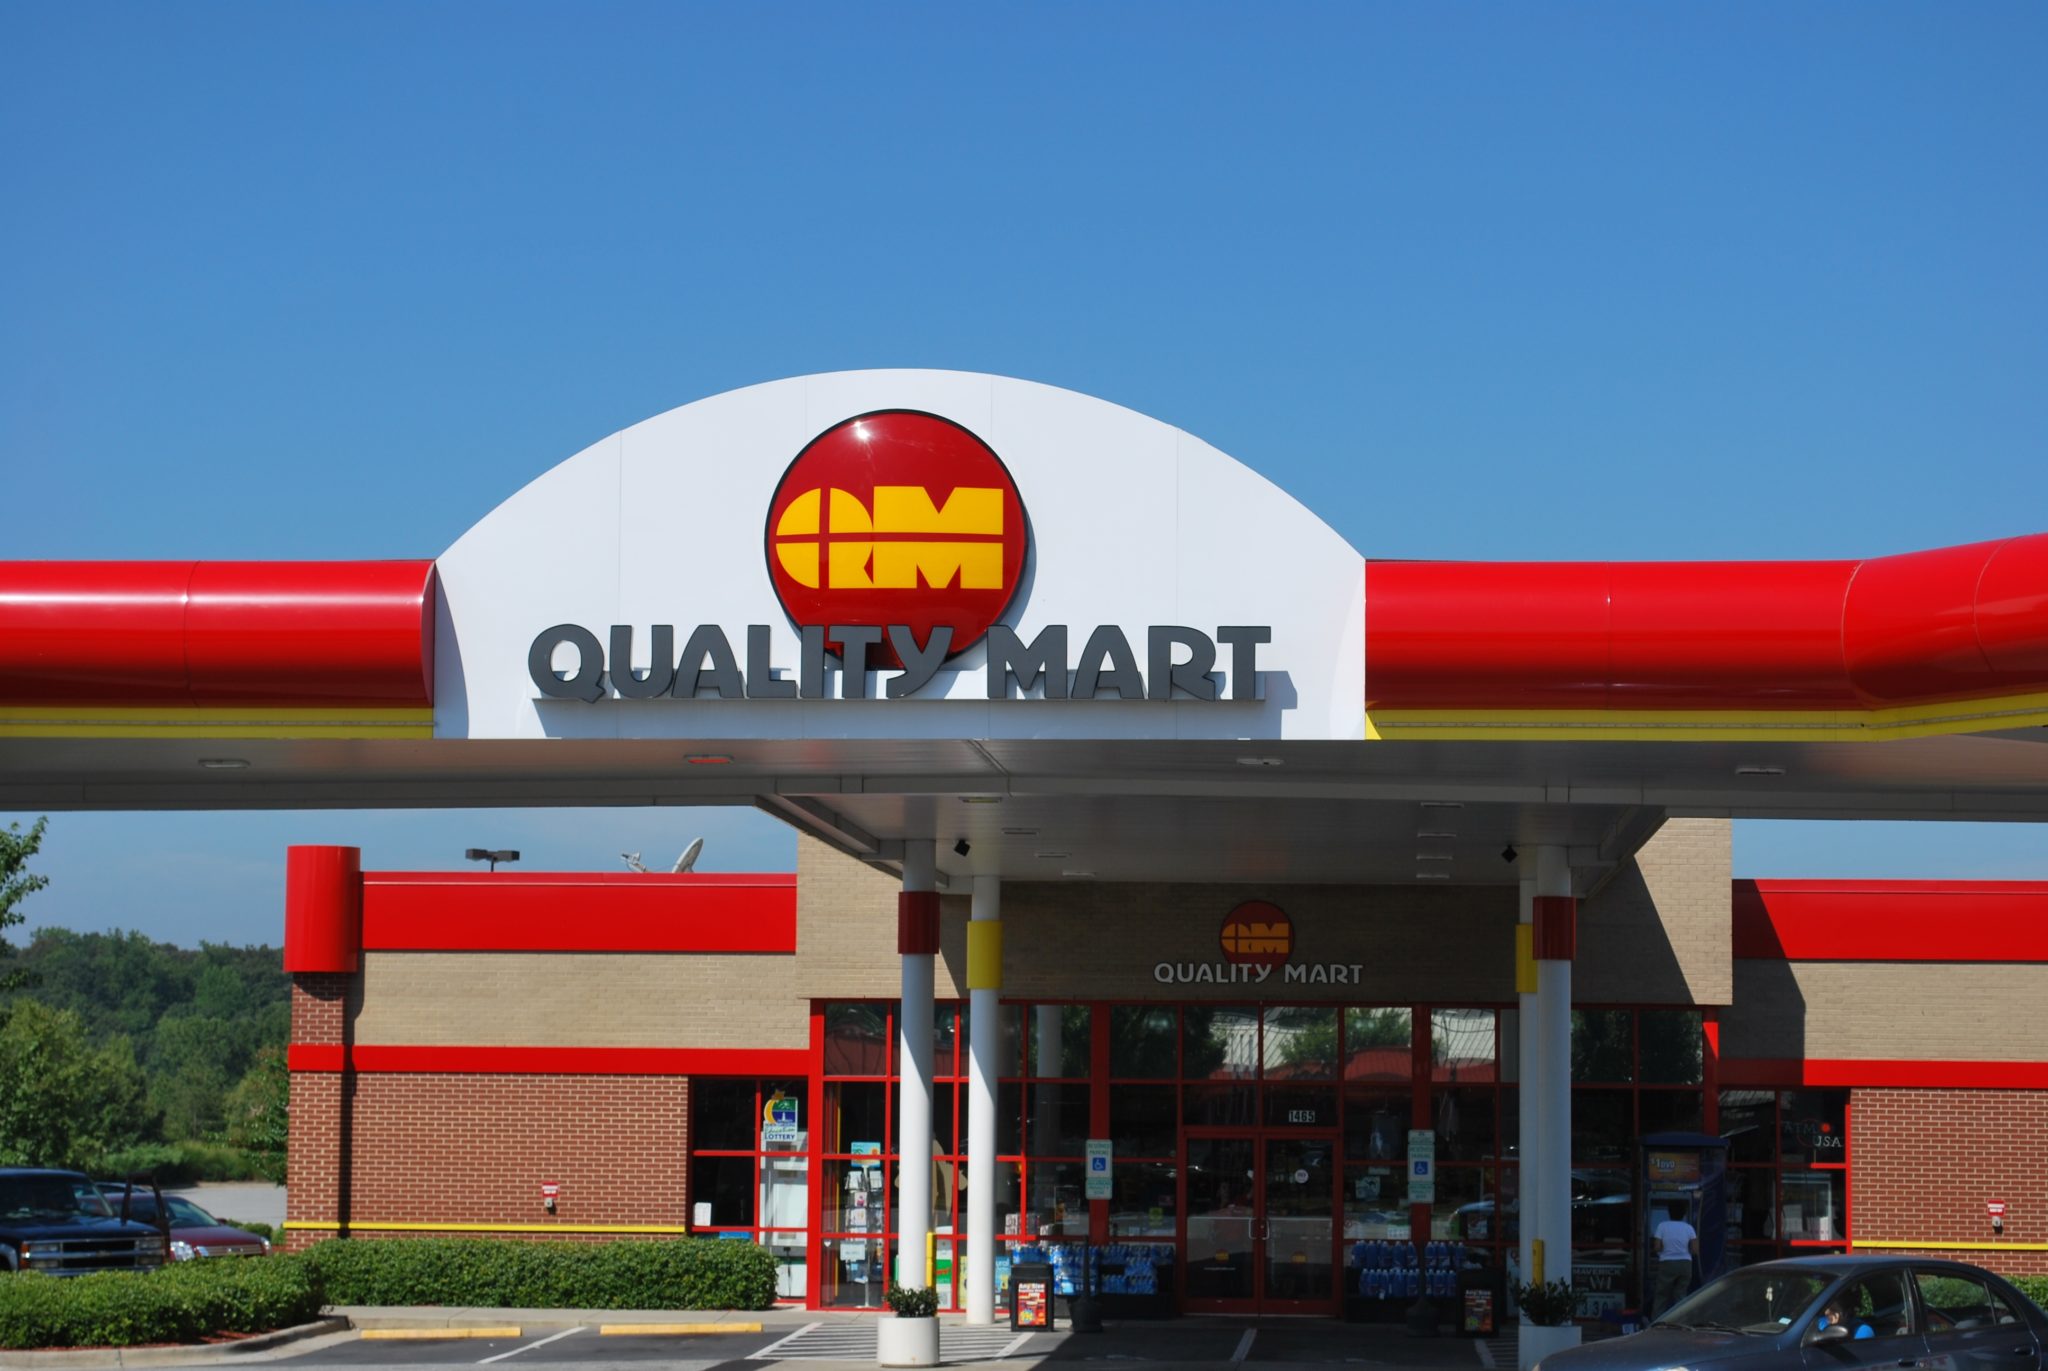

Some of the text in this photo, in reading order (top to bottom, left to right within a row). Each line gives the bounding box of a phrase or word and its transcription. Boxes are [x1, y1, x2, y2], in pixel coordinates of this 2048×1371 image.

[528, 623, 1272, 704] QUALITY MART
[1153, 962, 1364, 984] QUALITY MART
[1289, 1110, 1315, 1122] 1465
[764, 1133, 796, 1141] LOTTERY
[1812, 1135, 1844, 1148] USA
